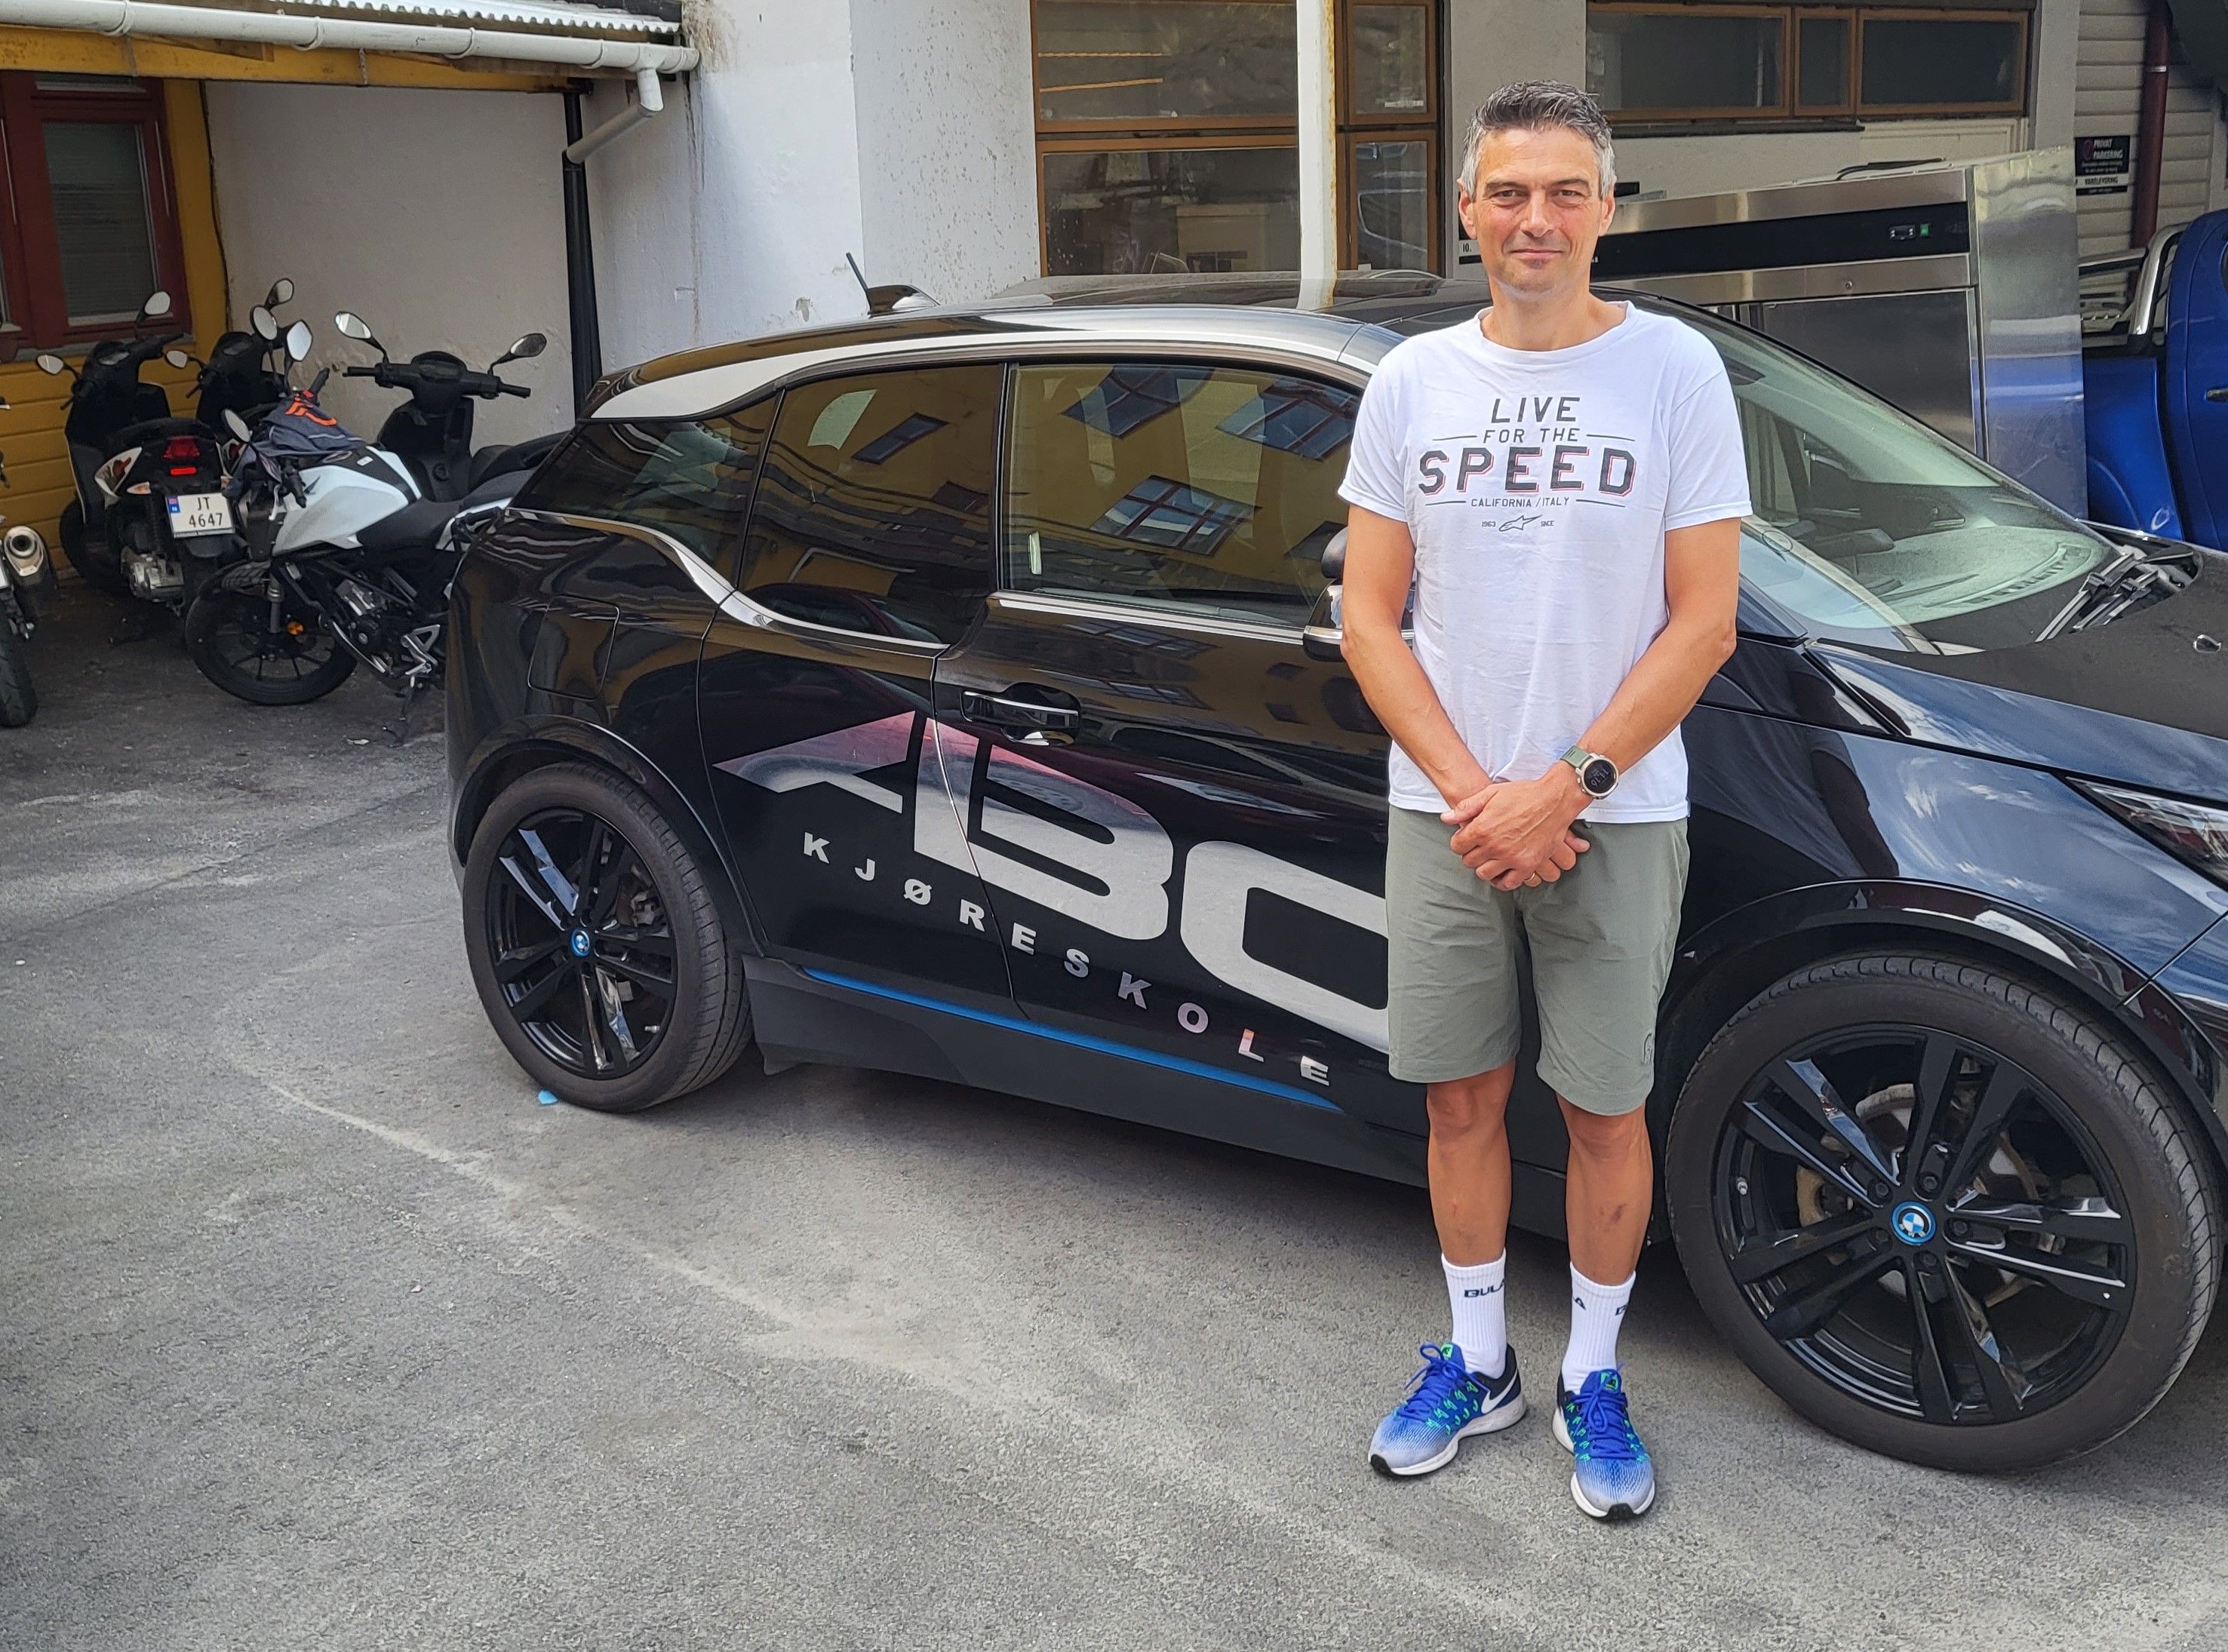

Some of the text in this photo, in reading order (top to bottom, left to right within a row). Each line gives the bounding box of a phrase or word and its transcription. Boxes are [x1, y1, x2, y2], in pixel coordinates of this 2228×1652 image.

[1491, 397, 1580, 423] LIVE
[1483, 428, 1580, 444] FOR THE
[1418, 445, 1636, 497] SPEED
[197, 497, 210, 511] JT
[1471, 498, 1532, 508] CALIFORNIA
[189, 513, 223, 528] 4647
[803, 831, 1330, 1087] KJØRESKOLE
